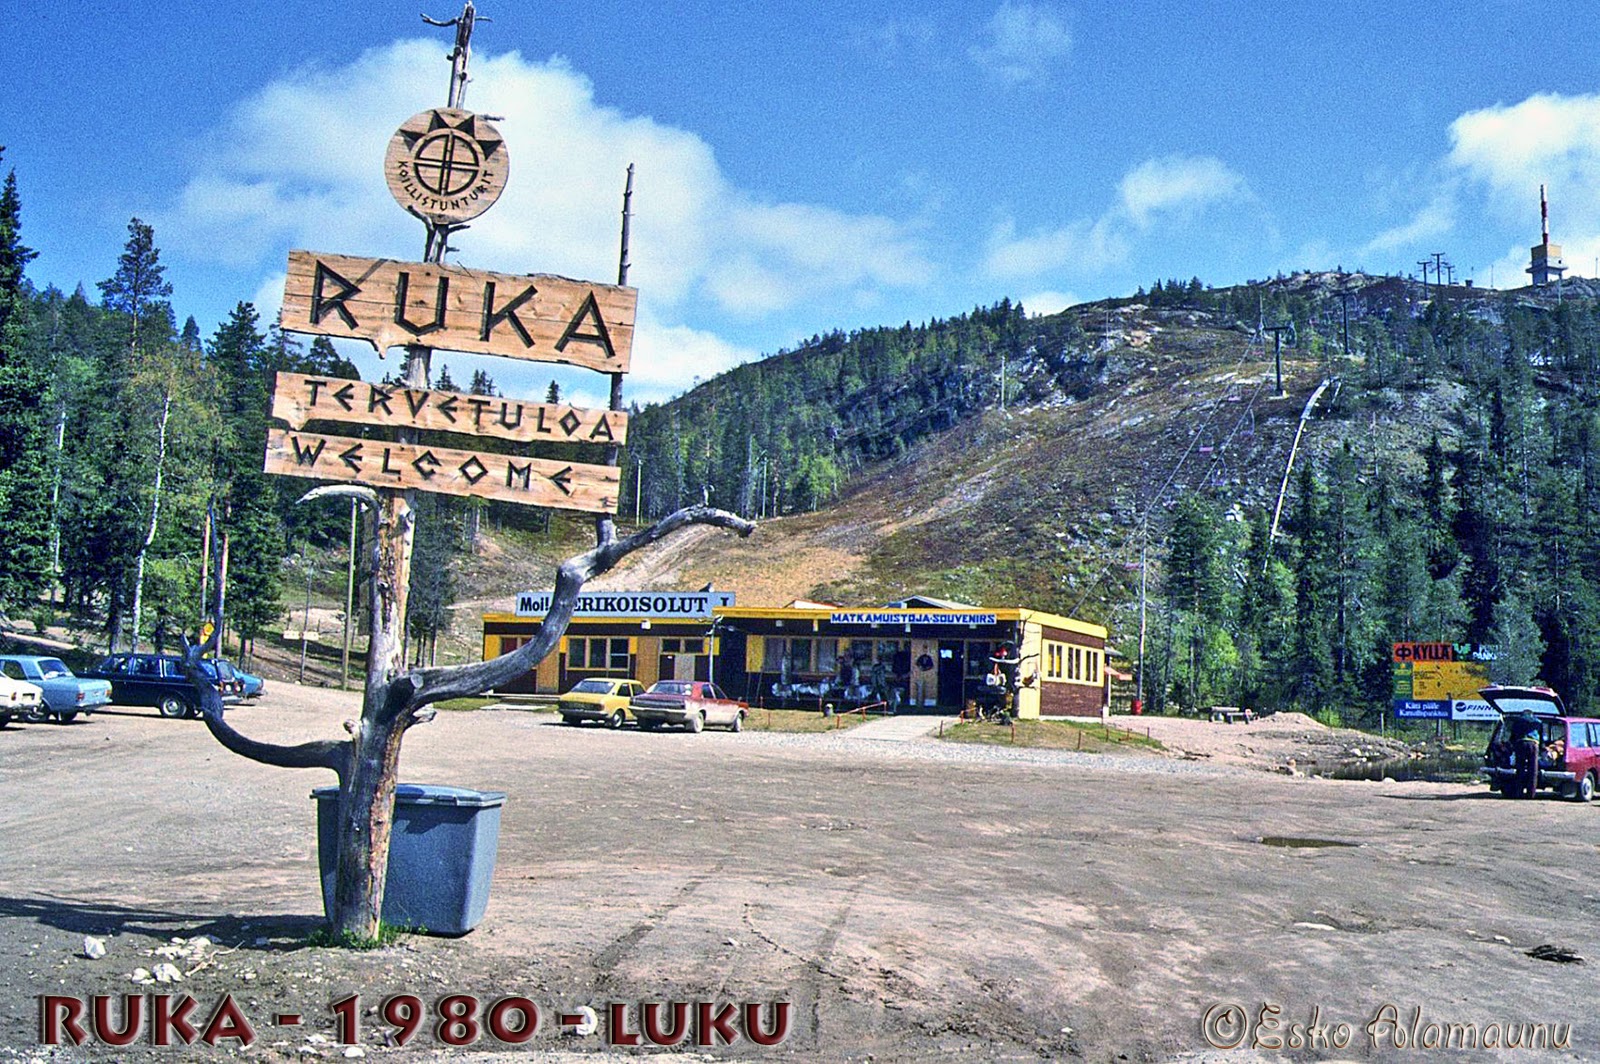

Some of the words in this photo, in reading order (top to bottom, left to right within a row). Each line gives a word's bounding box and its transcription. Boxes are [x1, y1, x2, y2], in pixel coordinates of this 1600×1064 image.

[398, 160, 494, 211] KOILLISTUNTURIT
[309, 259, 616, 358] RUKA
[304, 379, 613, 441] TERVETULOA
[291, 436, 573, 496] WELCOME
[520, 596, 549, 612] Moi!
